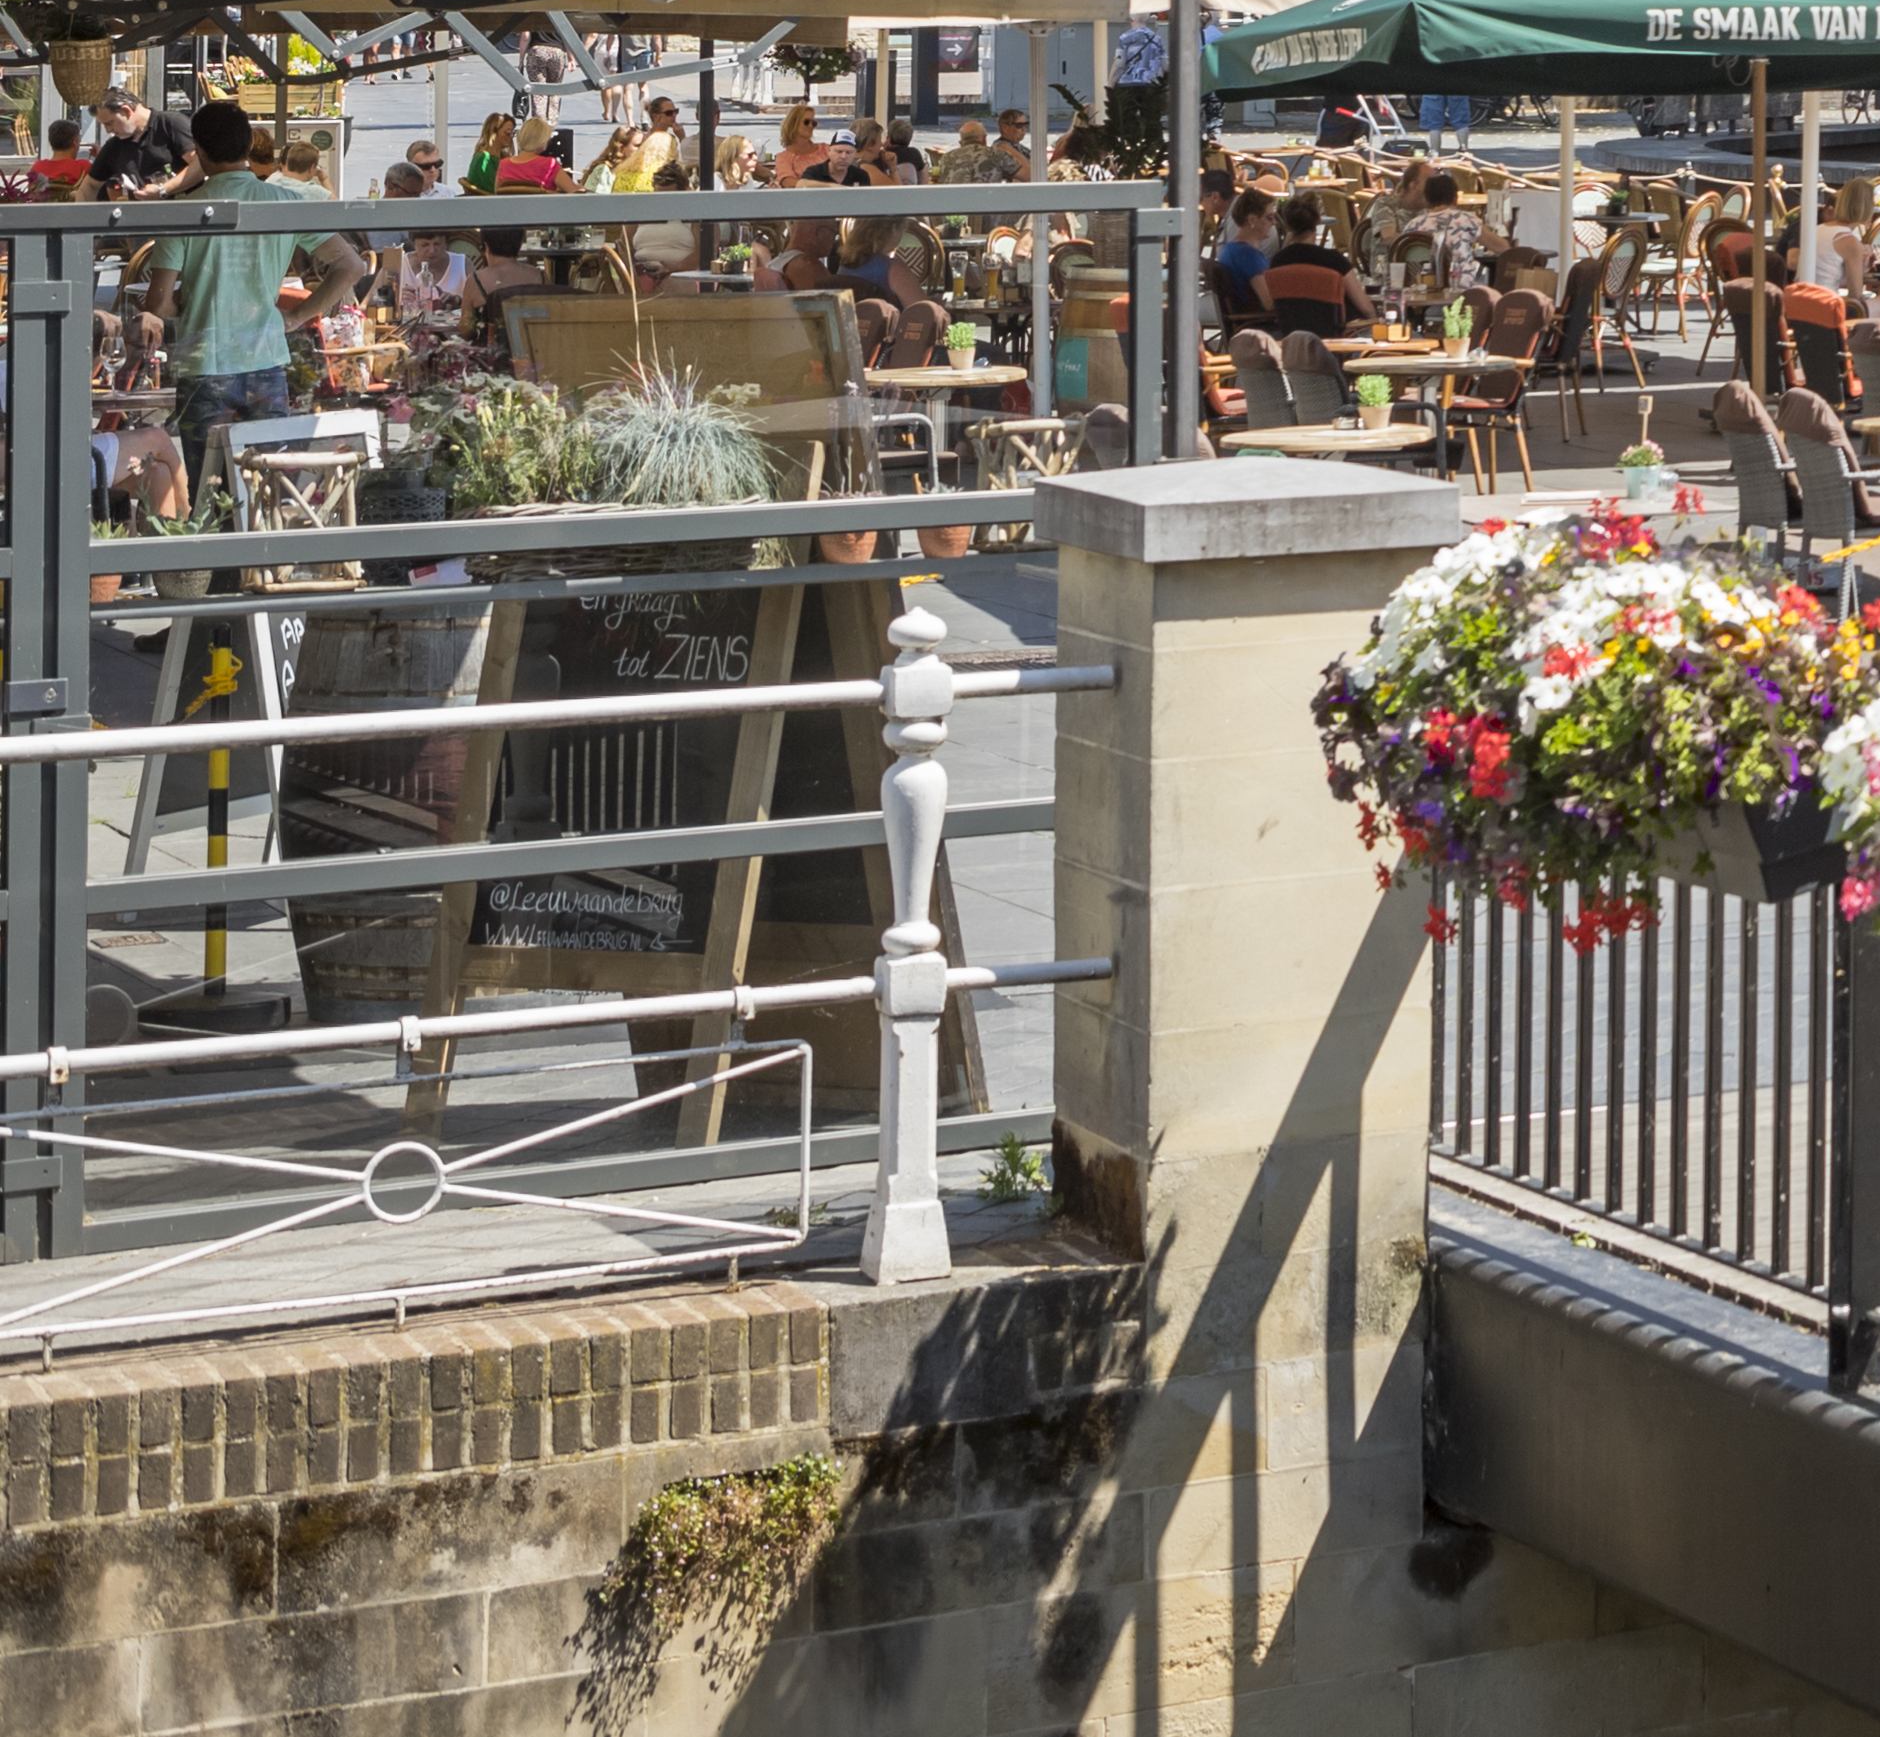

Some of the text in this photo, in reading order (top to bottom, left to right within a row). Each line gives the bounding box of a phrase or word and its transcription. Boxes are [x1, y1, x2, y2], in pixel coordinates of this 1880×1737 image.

[1645, 7, 1684, 42] DE
[1693, 7, 1800, 40] SMAAK
[1810, 5, 1867, 40] VAN
[613, 634, 748, 681] tot ZIENS
